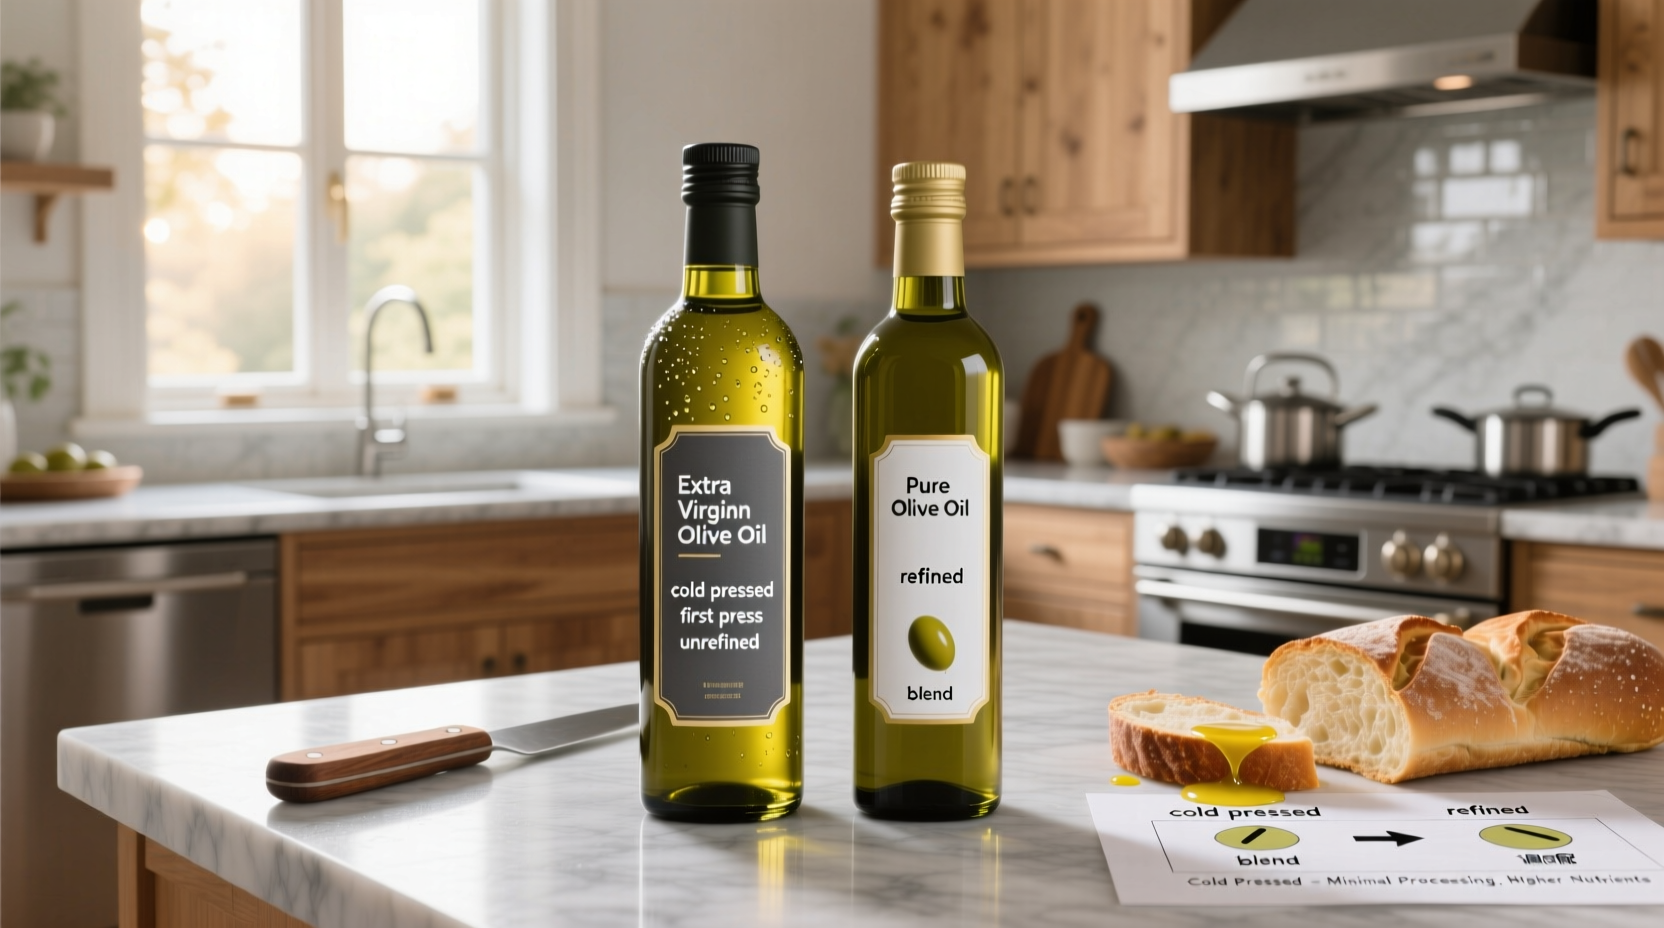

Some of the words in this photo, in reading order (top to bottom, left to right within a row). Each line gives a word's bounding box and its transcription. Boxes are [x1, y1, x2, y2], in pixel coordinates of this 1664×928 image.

[678, 474, 731, 495] Extra
[906, 476, 950, 494] Pure
[677, 499, 751, 525] Virginn
[891, 498, 939, 517] Olive
[943, 498, 969, 517] Oil
[677, 524, 732, 545] Olive
[737, 523, 767, 544] Oil
[900, 567, 963, 584] refined
[670, 581, 705, 598] cold
[710, 580, 774, 602] pressed
[680, 606, 714, 624] first
[719, 610, 763, 629] press
[680, 632, 760, 650] unrefined
[907, 685, 953, 701] blend
[1169, 806, 1220, 818] cold
[1228, 806, 1322, 821] pressed
[1447, 805, 1530, 816] refined
[1237, 855, 1301, 866] blend
[1187, 877, 1227, 886] Cold
[1326, 876, 1392, 886] Minimal
